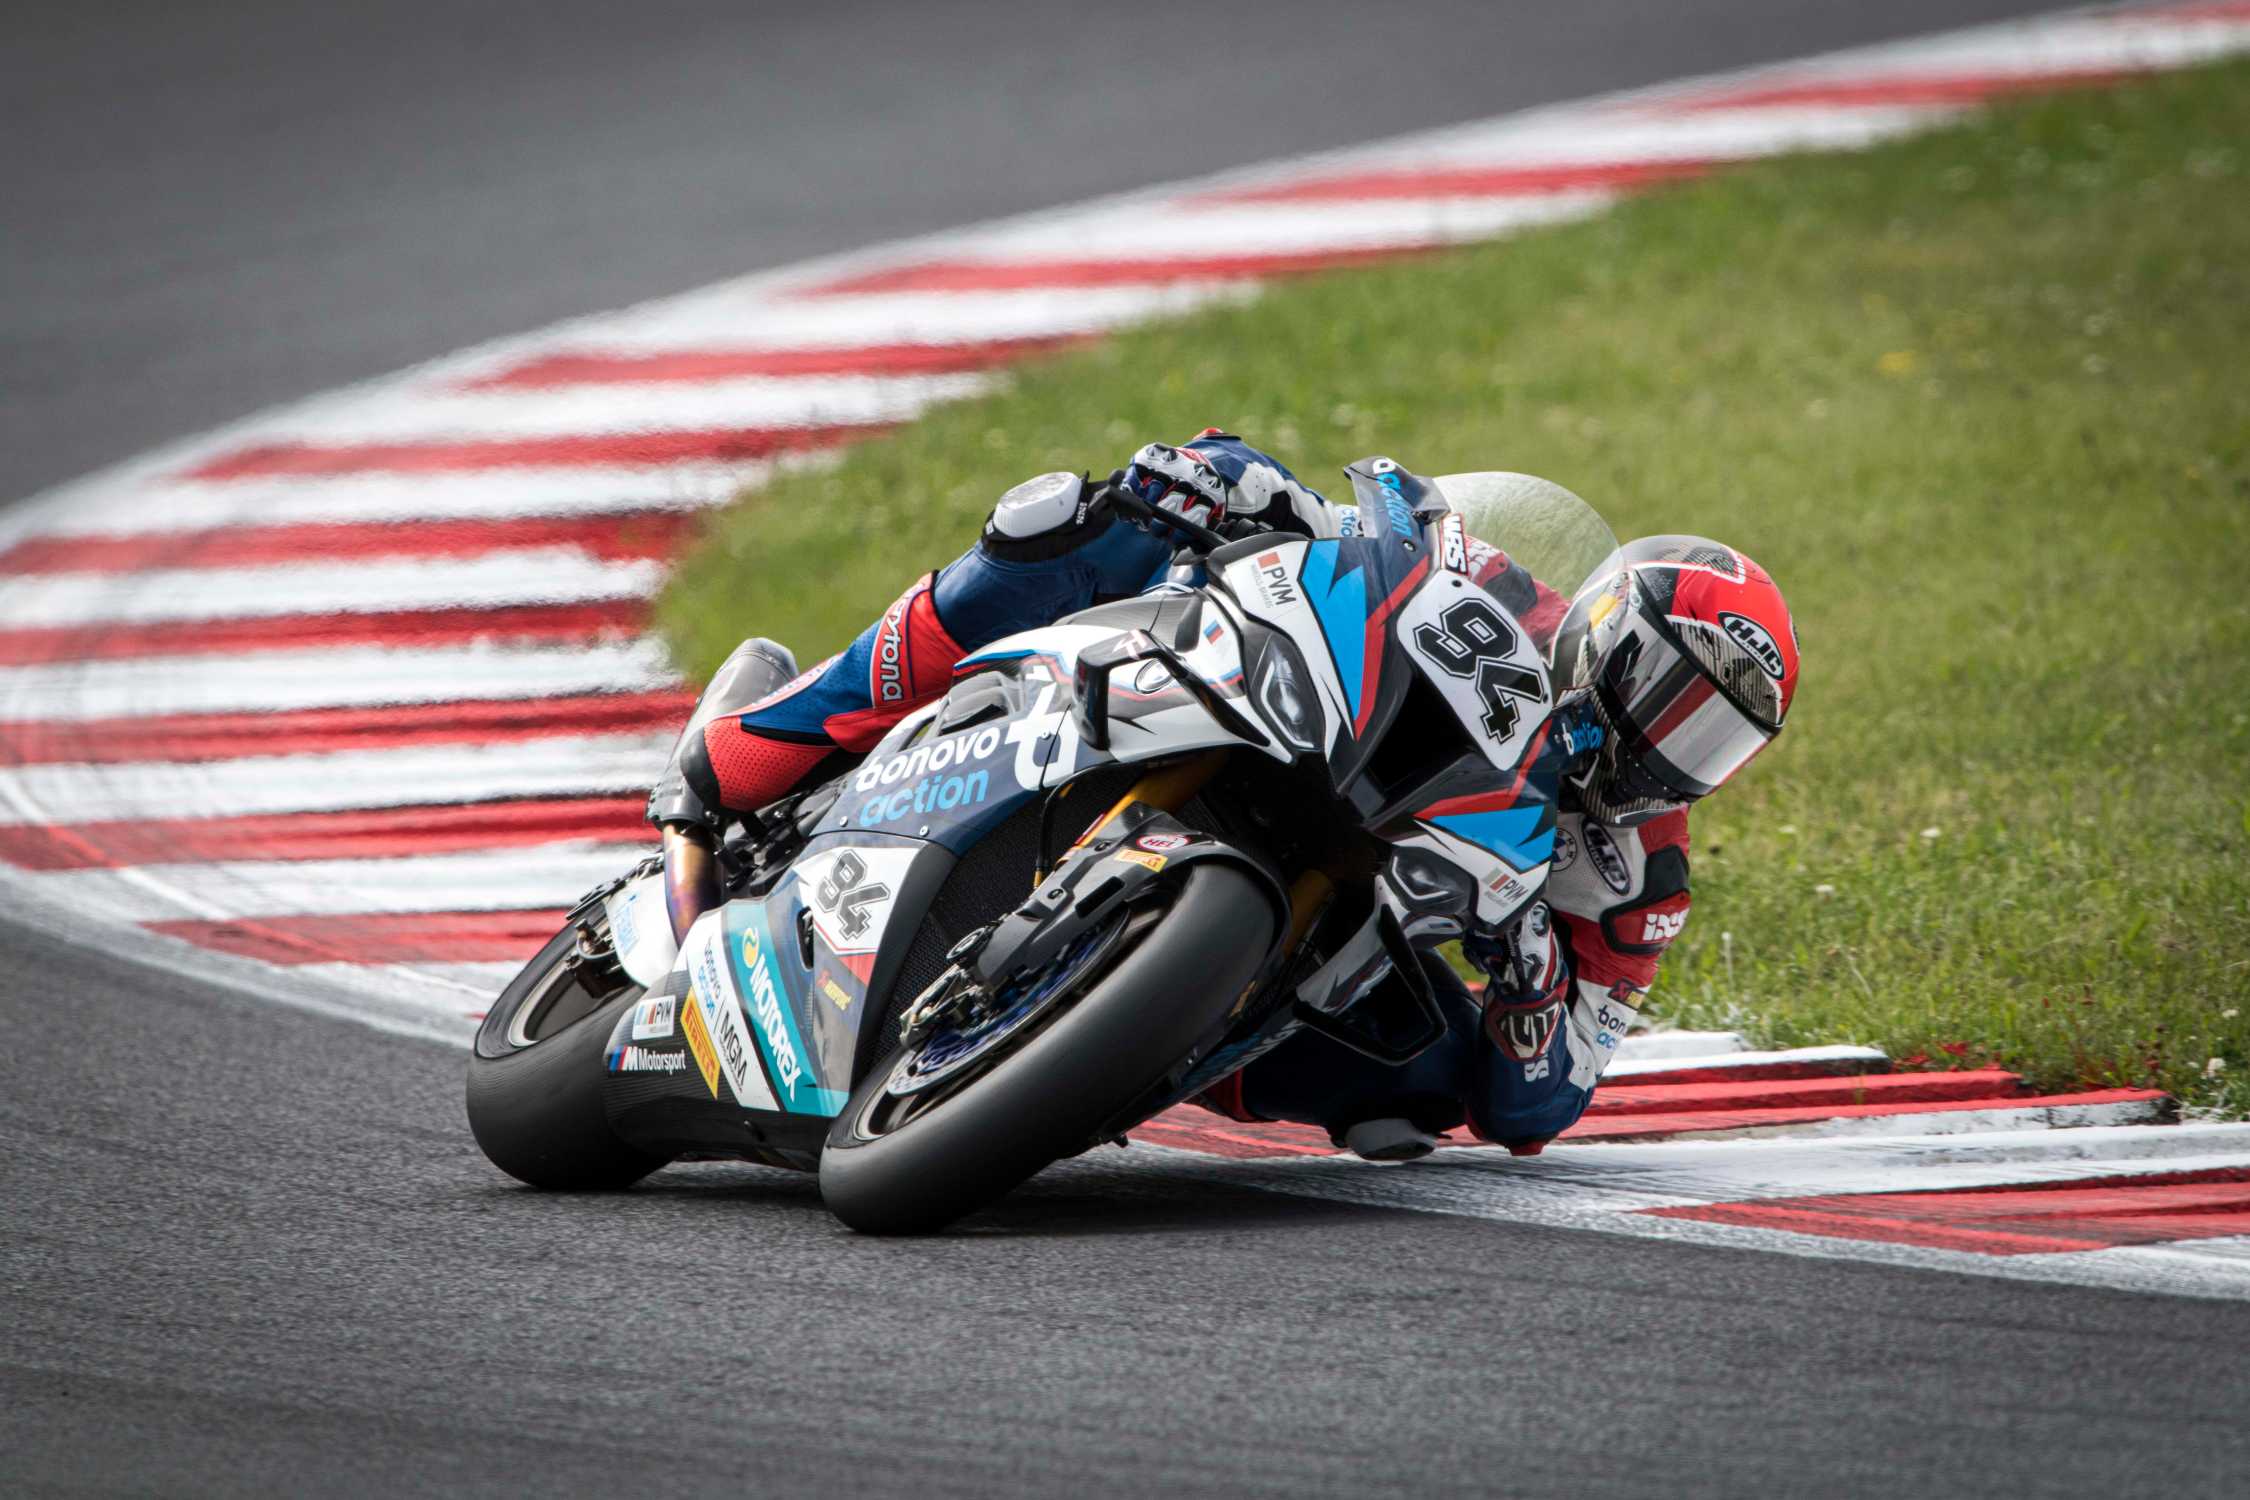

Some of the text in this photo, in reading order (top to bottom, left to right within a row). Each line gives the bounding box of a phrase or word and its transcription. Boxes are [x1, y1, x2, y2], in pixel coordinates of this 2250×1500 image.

[1443, 514, 1468, 574] WRS
[1263, 566, 1297, 605] PVM
[1412, 597, 1545, 745] 84
[1726, 619, 1781, 673] HJC
[856, 727, 1000, 792] bonovo
[859, 769, 989, 827] action
[815, 849, 892, 941] 84
[1496, 879, 1529, 903] PVM
[656, 1001, 675, 1025] PVM
[750, 953, 802, 1102] MOTOREX
[638, 1048, 687, 1075] Motorsport
[721, 1010, 748, 1087] MGM
